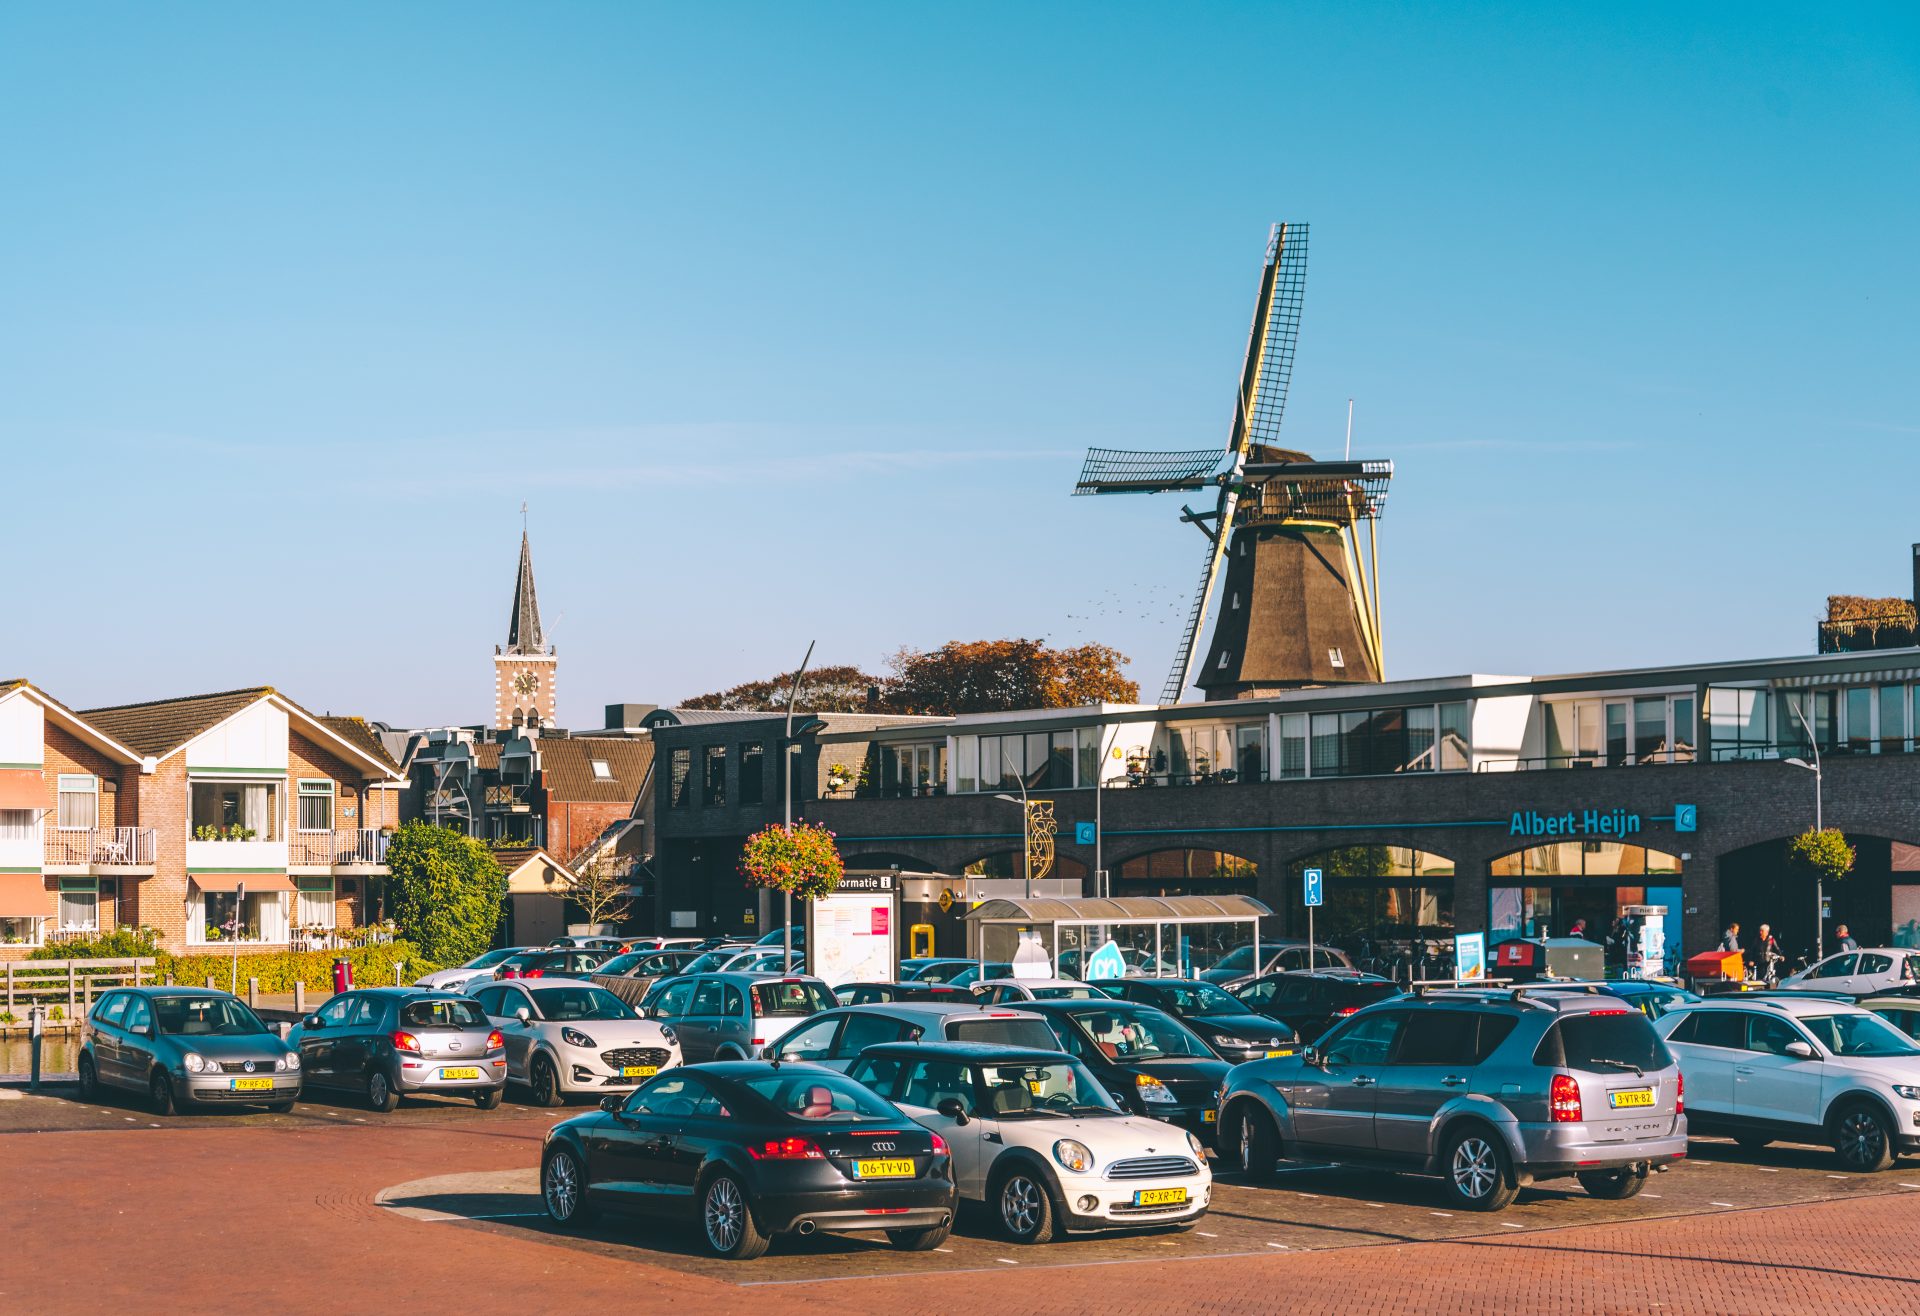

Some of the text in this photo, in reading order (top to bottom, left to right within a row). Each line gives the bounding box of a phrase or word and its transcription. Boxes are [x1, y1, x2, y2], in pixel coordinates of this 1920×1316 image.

[1510, 808, 1640, 838] Albert Heijn
[836, 877, 878, 888] formatie
[1308, 872, 1318, 891] P
[625, 1067, 655, 1076] K-545-SN
[1617, 1093, 1652, 1105] 3-VTR-82
[861, 1162, 912, 1175] 06-TV-VD
[1143, 1190, 1183, 1203] 29-XR-TZ
